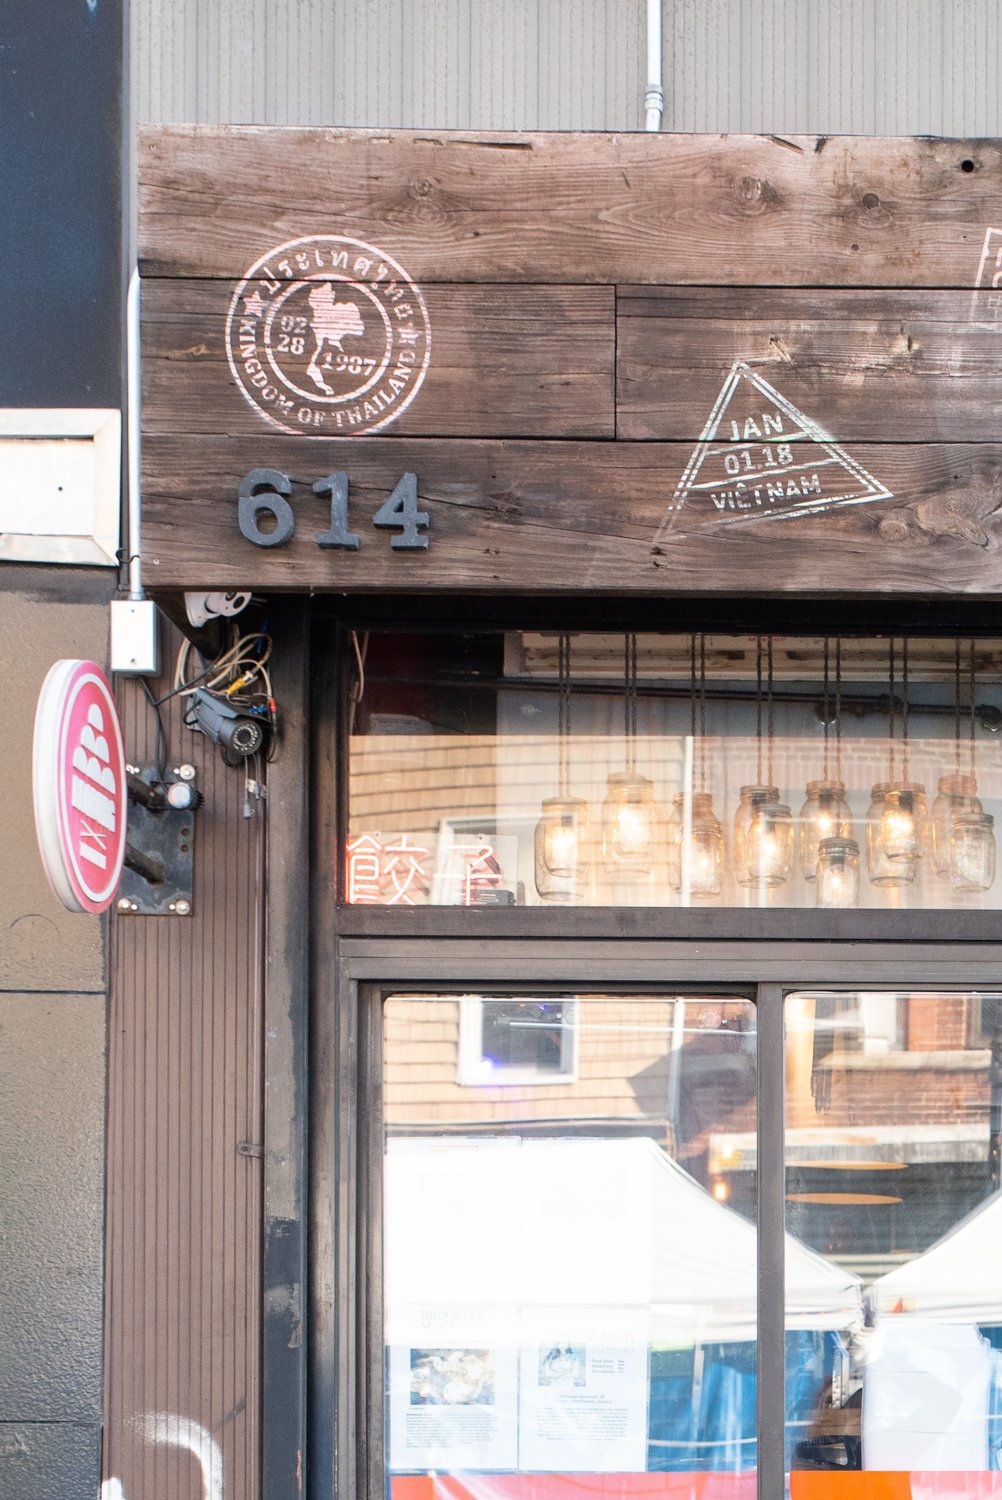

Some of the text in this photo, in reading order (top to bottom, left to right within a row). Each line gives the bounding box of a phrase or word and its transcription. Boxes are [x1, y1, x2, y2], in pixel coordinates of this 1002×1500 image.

[276, 333, 305, 355] 28
[239, 319, 417, 427] KINGDOM OF THAILAND
[320, 351, 377, 376] 1987
[730, 411, 784, 441] JAN
[723, 443, 794, 475] 01.18
[238, 468, 430, 550] 614
[346, 832, 502, 906] 餃子
